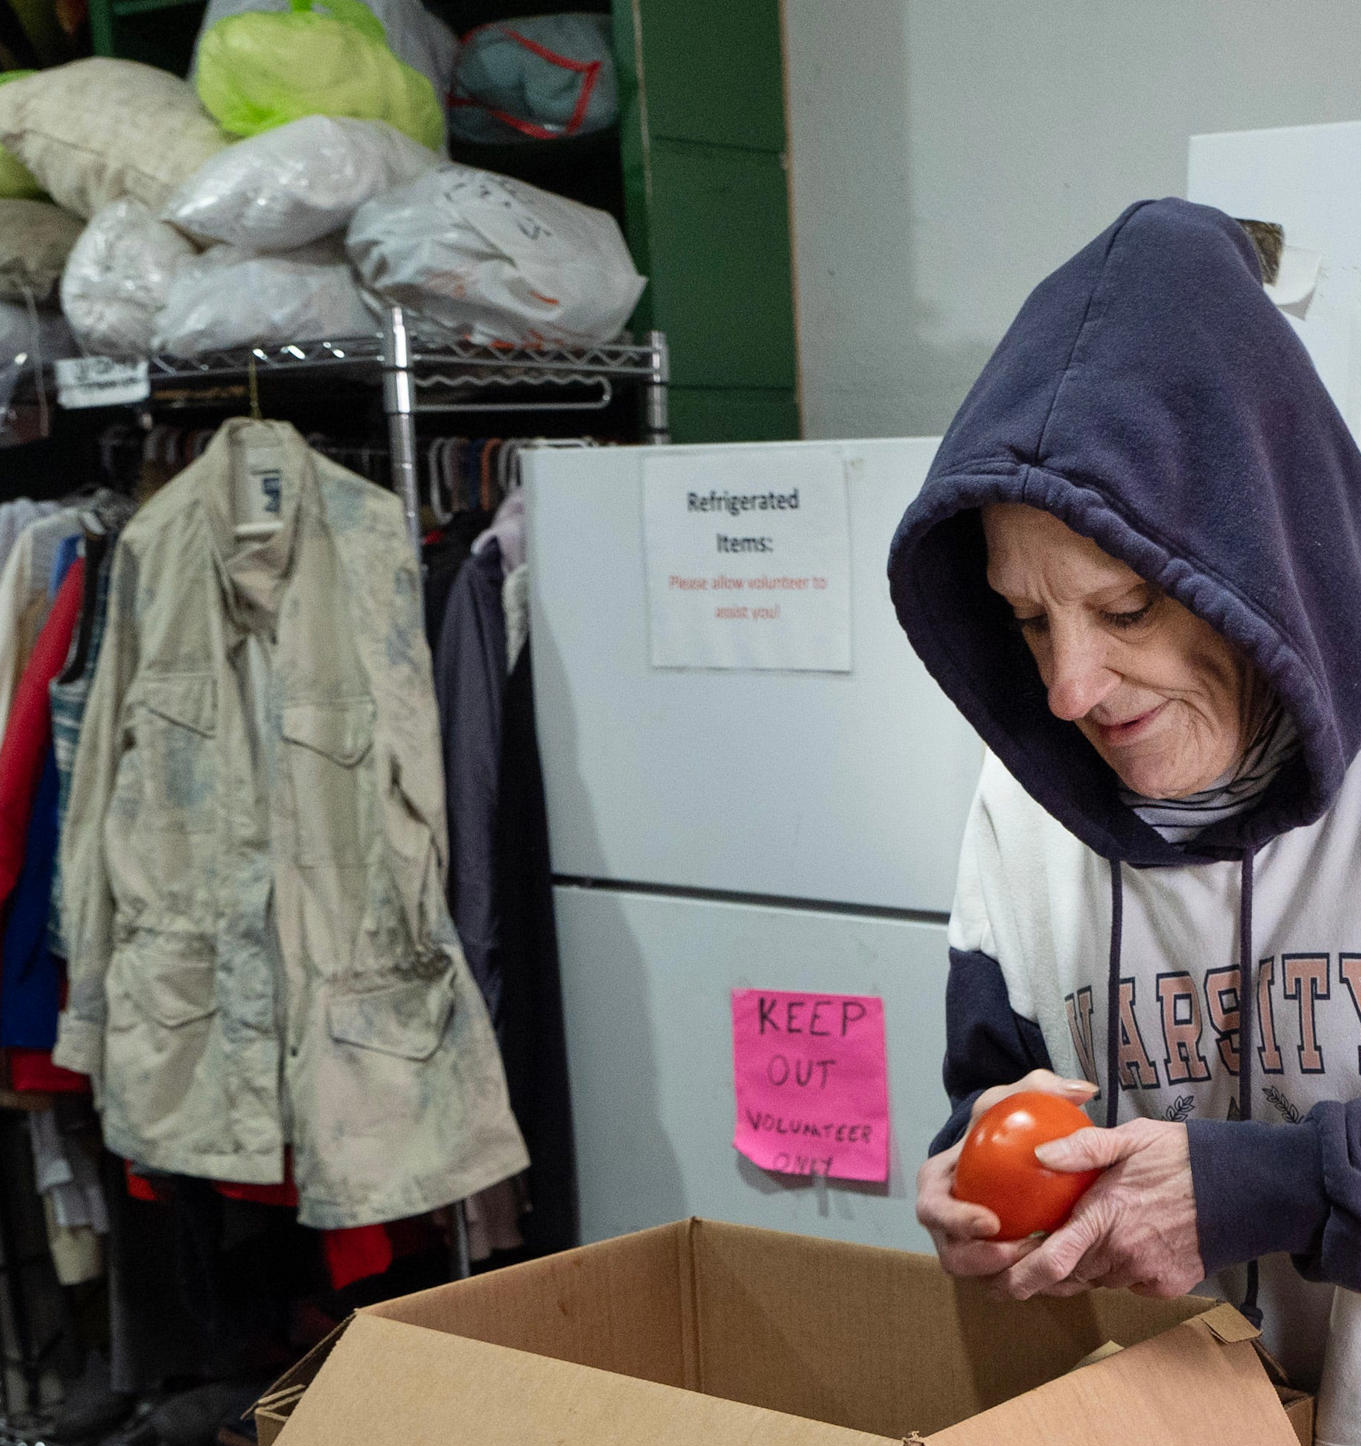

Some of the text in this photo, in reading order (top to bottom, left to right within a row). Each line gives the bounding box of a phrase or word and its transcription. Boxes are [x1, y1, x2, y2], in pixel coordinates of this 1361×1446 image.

[687, 489, 800, 515] Refrigerated
[716, 532, 773, 554] Items:
[668, 574, 827, 591] Please allow volunteer to
[758, 997, 867, 1037] KEEP
[767, 1055, 837, 1089] OUT
